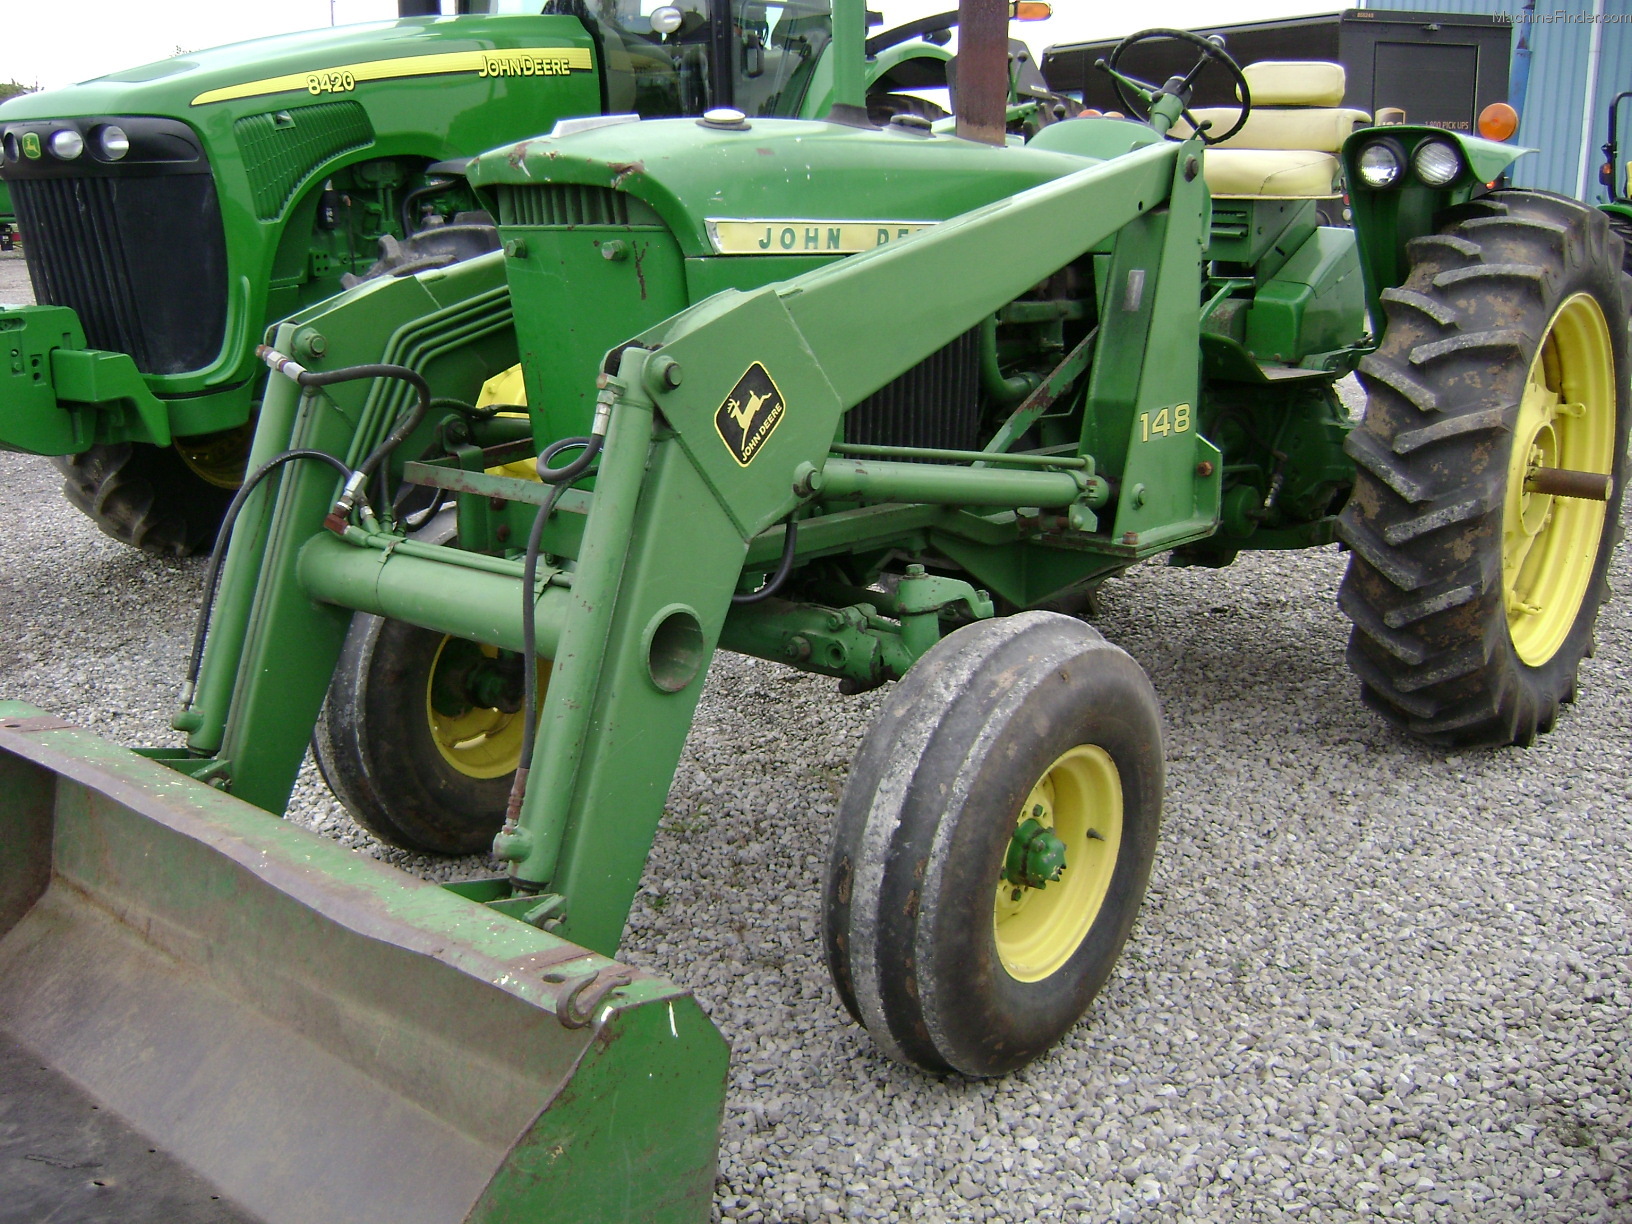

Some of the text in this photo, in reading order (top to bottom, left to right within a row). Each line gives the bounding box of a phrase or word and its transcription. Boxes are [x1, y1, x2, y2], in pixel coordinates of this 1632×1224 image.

[306, 71, 355, 96] 8420
[1457, 121, 1469, 130] UPS
[758, 227, 841, 250] JOHN
[742, 402, 783, 462] JOHN DEERE
[1140, 403, 1190, 443] 148
